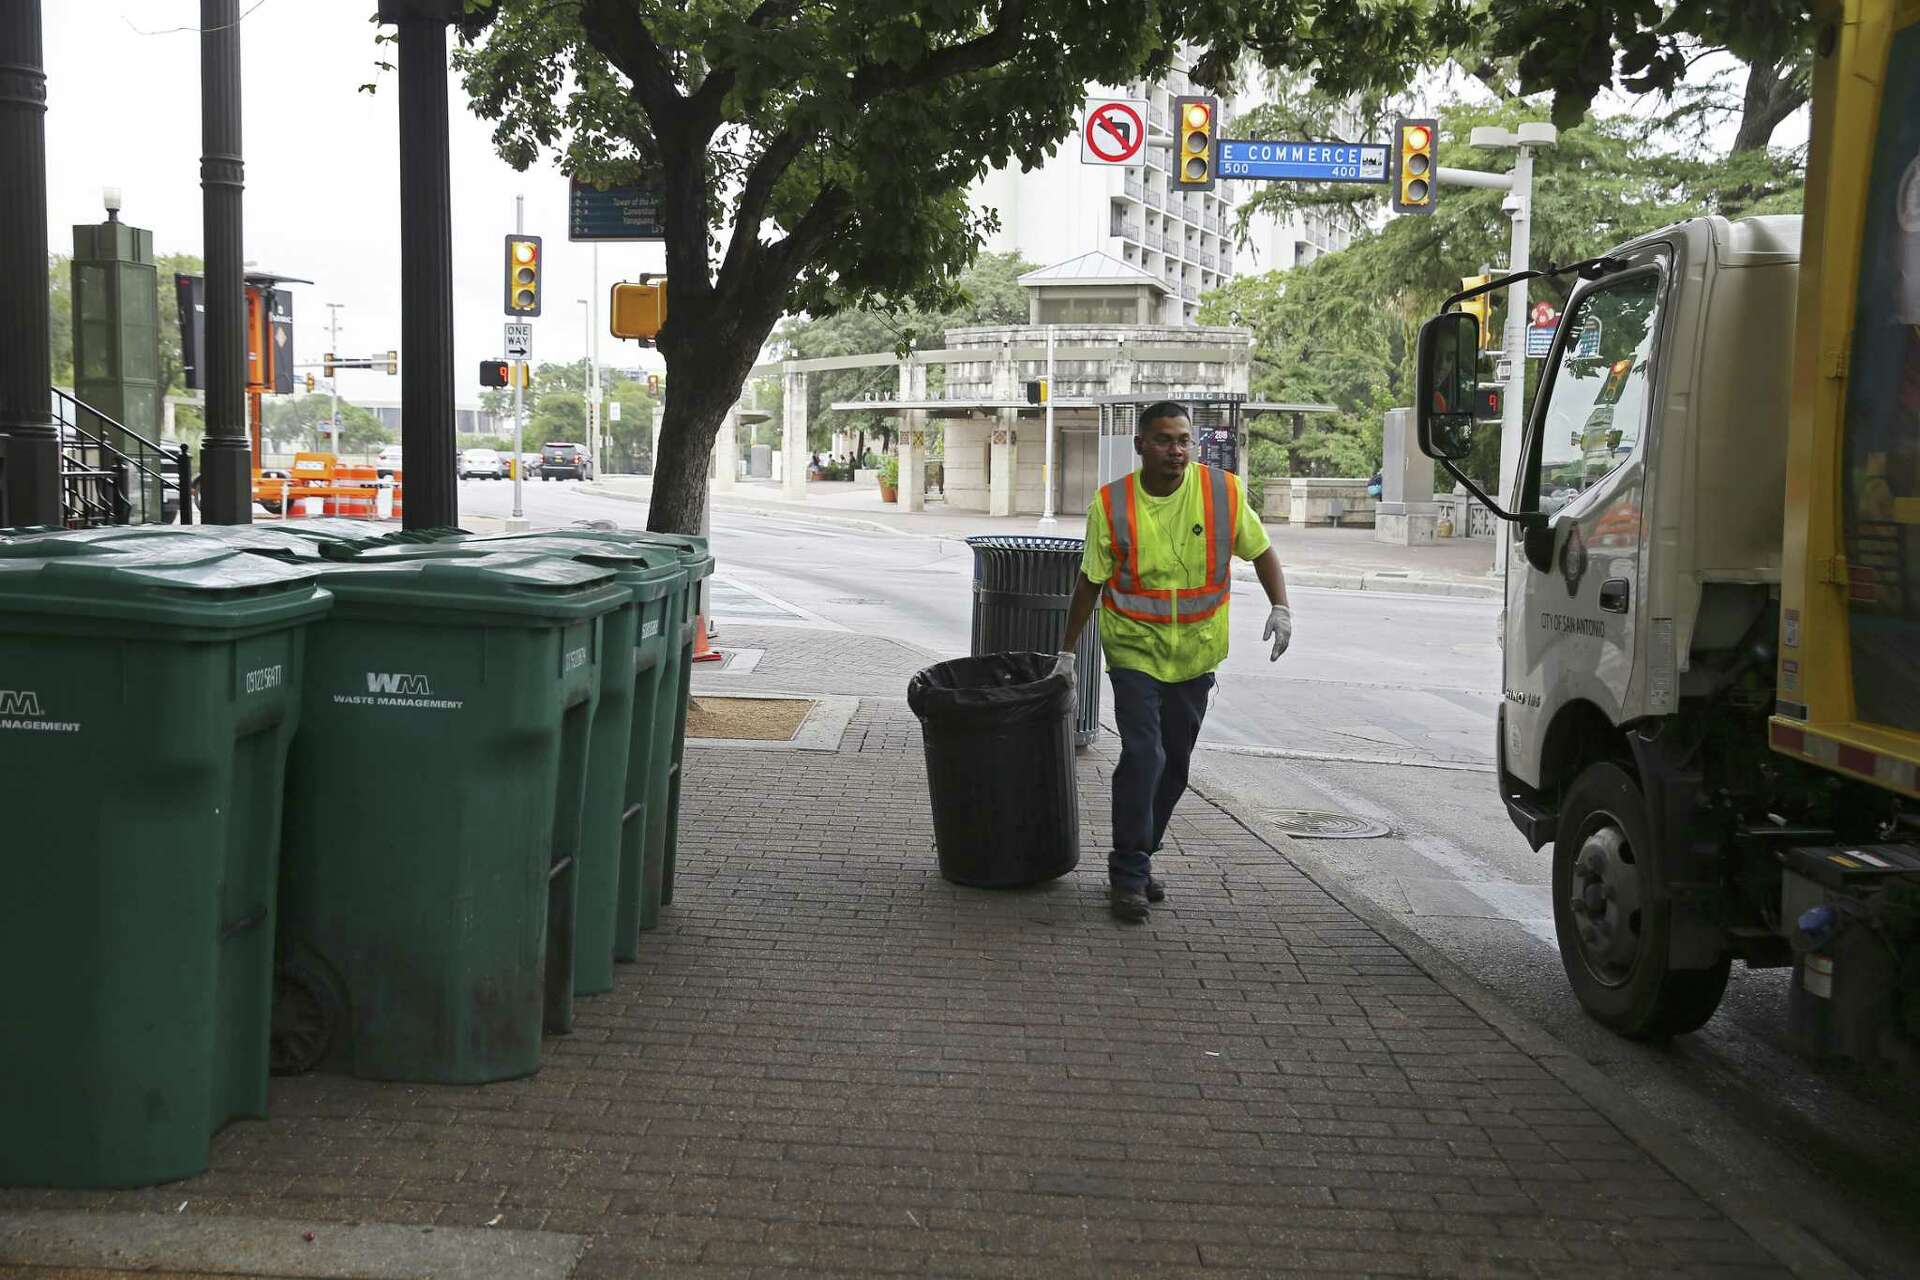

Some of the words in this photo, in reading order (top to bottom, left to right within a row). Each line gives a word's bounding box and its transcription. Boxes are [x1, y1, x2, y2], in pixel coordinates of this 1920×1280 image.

[1223, 145, 1233, 159] E
[1248, 146, 1358, 163] COMMERCE
[1224, 163, 1249, 174] 500
[1331, 166, 1356, 177] 400
[507, 326, 528, 336] ONE
[507, 336, 529, 345] WAY
[499, 366, 508, 383] 9
[1167, 392, 1213, 401] PUBLIC
[1488, 394, 1498, 413] 9
[1541, 612, 1554, 632] CITY
[1554, 614, 1562, 631] OF
[1563, 615, 1576, 633] SAN
[1576, 617, 1605, 638] ANTONIO
[366, 672, 431, 695] WM
[333, 695, 375, 705] WASTE
[377, 697, 463, 709] MANAGEMENT
